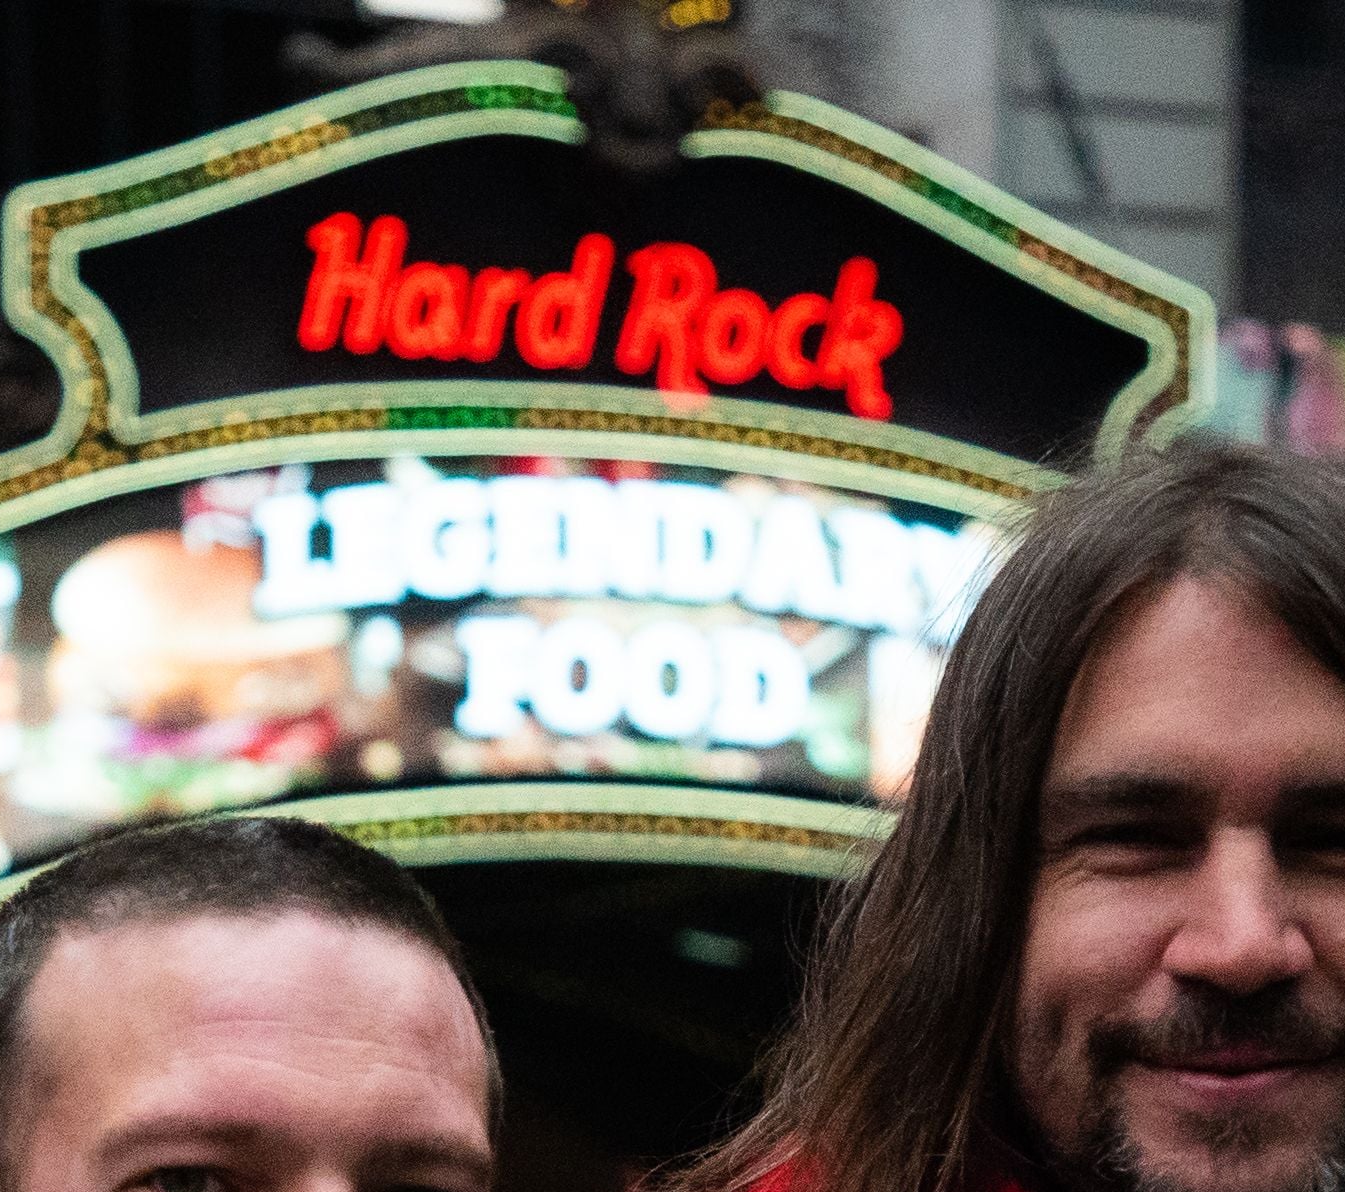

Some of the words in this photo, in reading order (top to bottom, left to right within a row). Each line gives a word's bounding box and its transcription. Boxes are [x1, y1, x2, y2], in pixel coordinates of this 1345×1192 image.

[298, 211, 614, 368] Hard
[615, 242, 904, 420] Rock
[456, 614, 812, 748] FOOD
